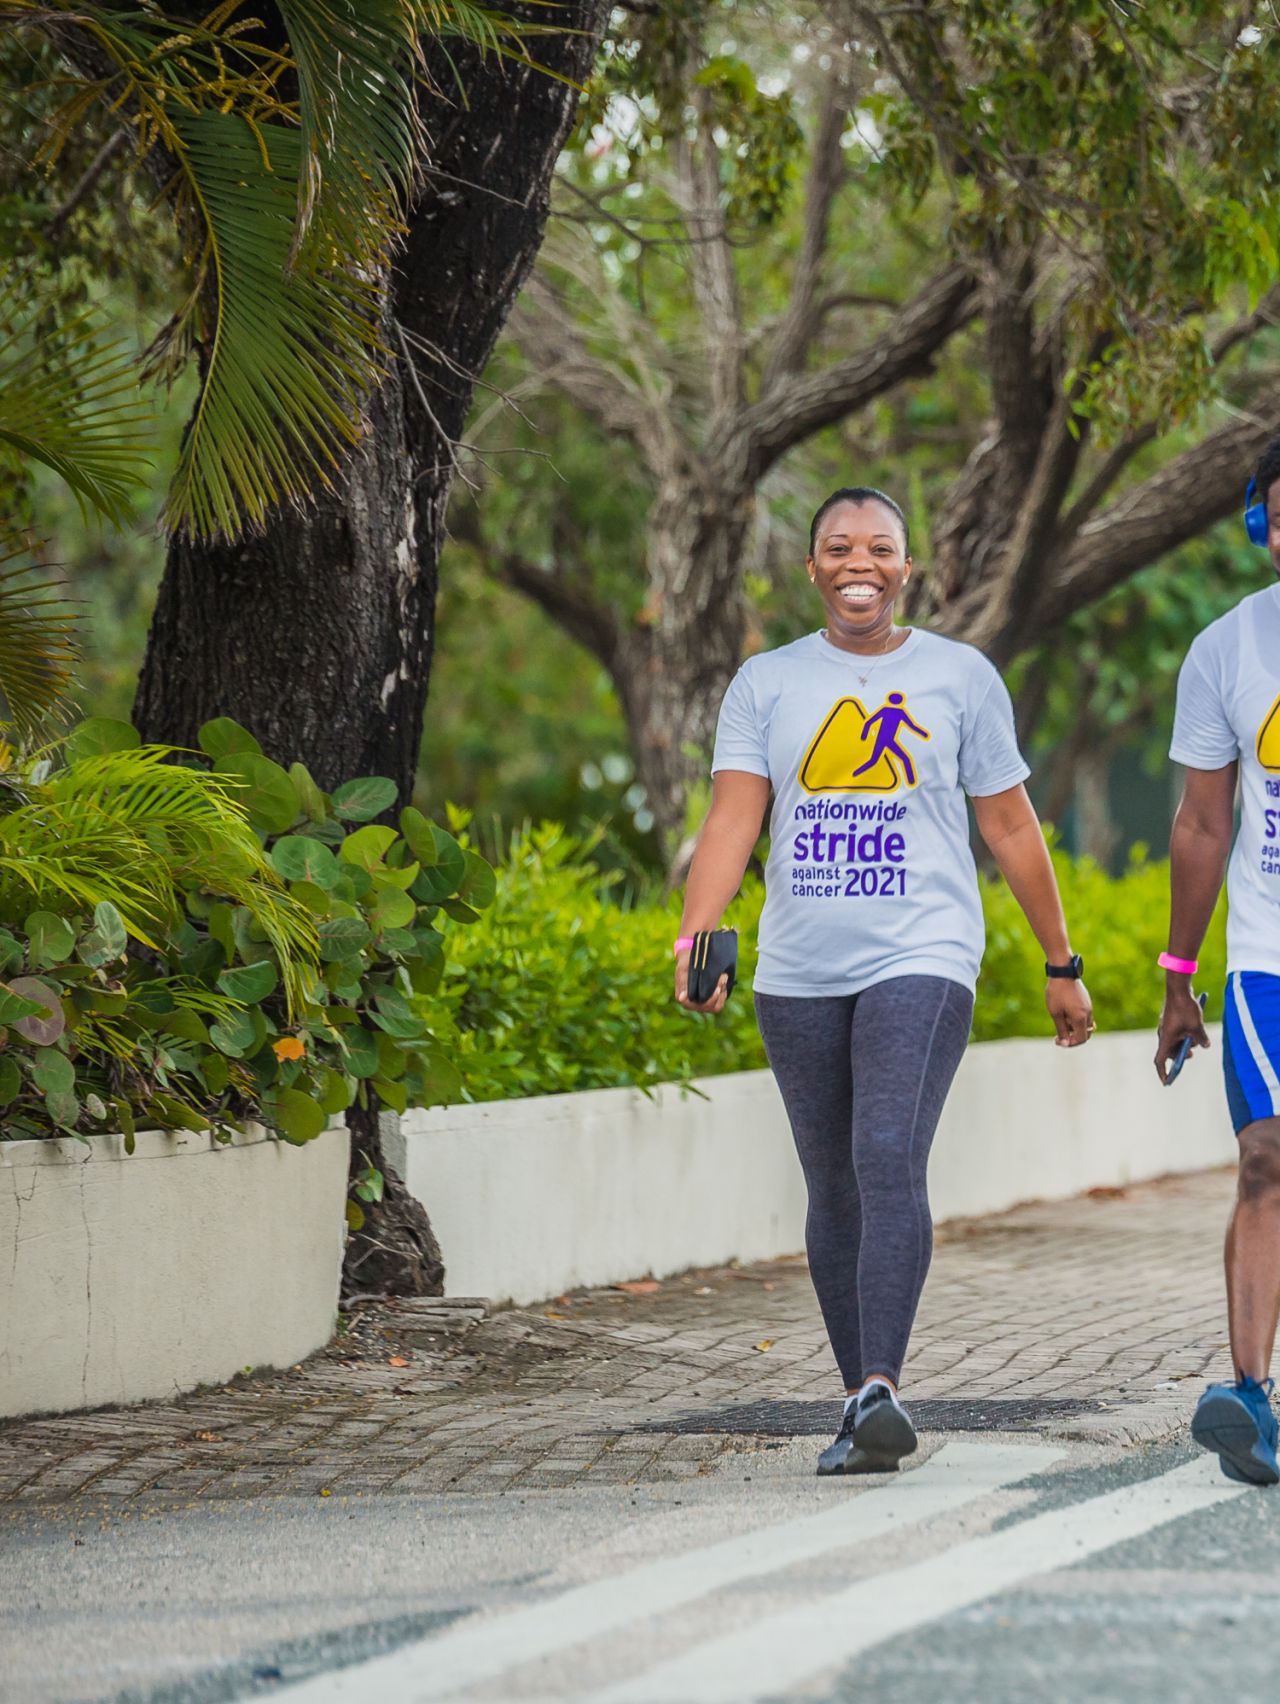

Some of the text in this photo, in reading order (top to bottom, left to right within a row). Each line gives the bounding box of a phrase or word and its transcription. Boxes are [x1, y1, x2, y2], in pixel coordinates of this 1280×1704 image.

[794, 799, 907, 821] nationwide
[793, 822, 906, 863] stride
[792, 866, 840, 882] against
[792, 868, 907, 897] cancer 2021
